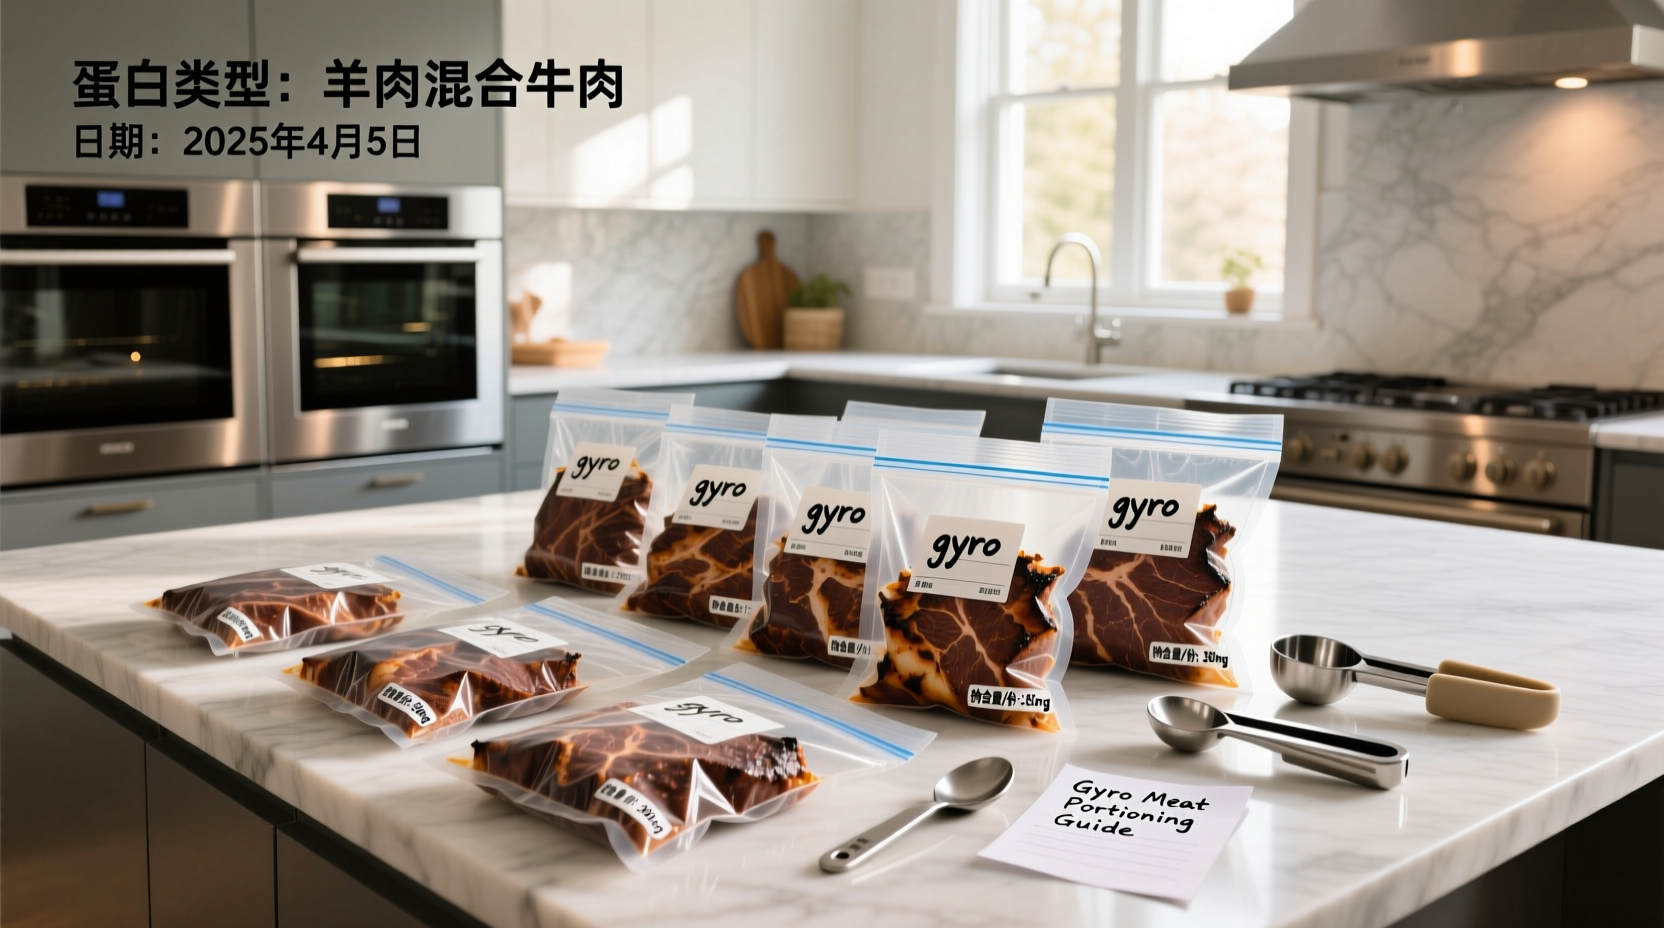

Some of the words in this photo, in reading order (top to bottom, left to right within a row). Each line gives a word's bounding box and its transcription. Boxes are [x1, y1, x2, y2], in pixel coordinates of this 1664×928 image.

[571, 456, 620, 480] gyro
[690, 480, 746, 507] gyro
[802, 504, 865, 535] gyro
[1108, 497, 1179, 530] gyro
[927, 535, 1001, 569] gyro
[664, 702, 744, 723] gyro
[1073, 780, 1132, 801] Gyro
[1141, 791, 1210, 811] Meat
[1054, 814, 1134, 836] Guide
[1064, 797, 1194, 834] Portioning
